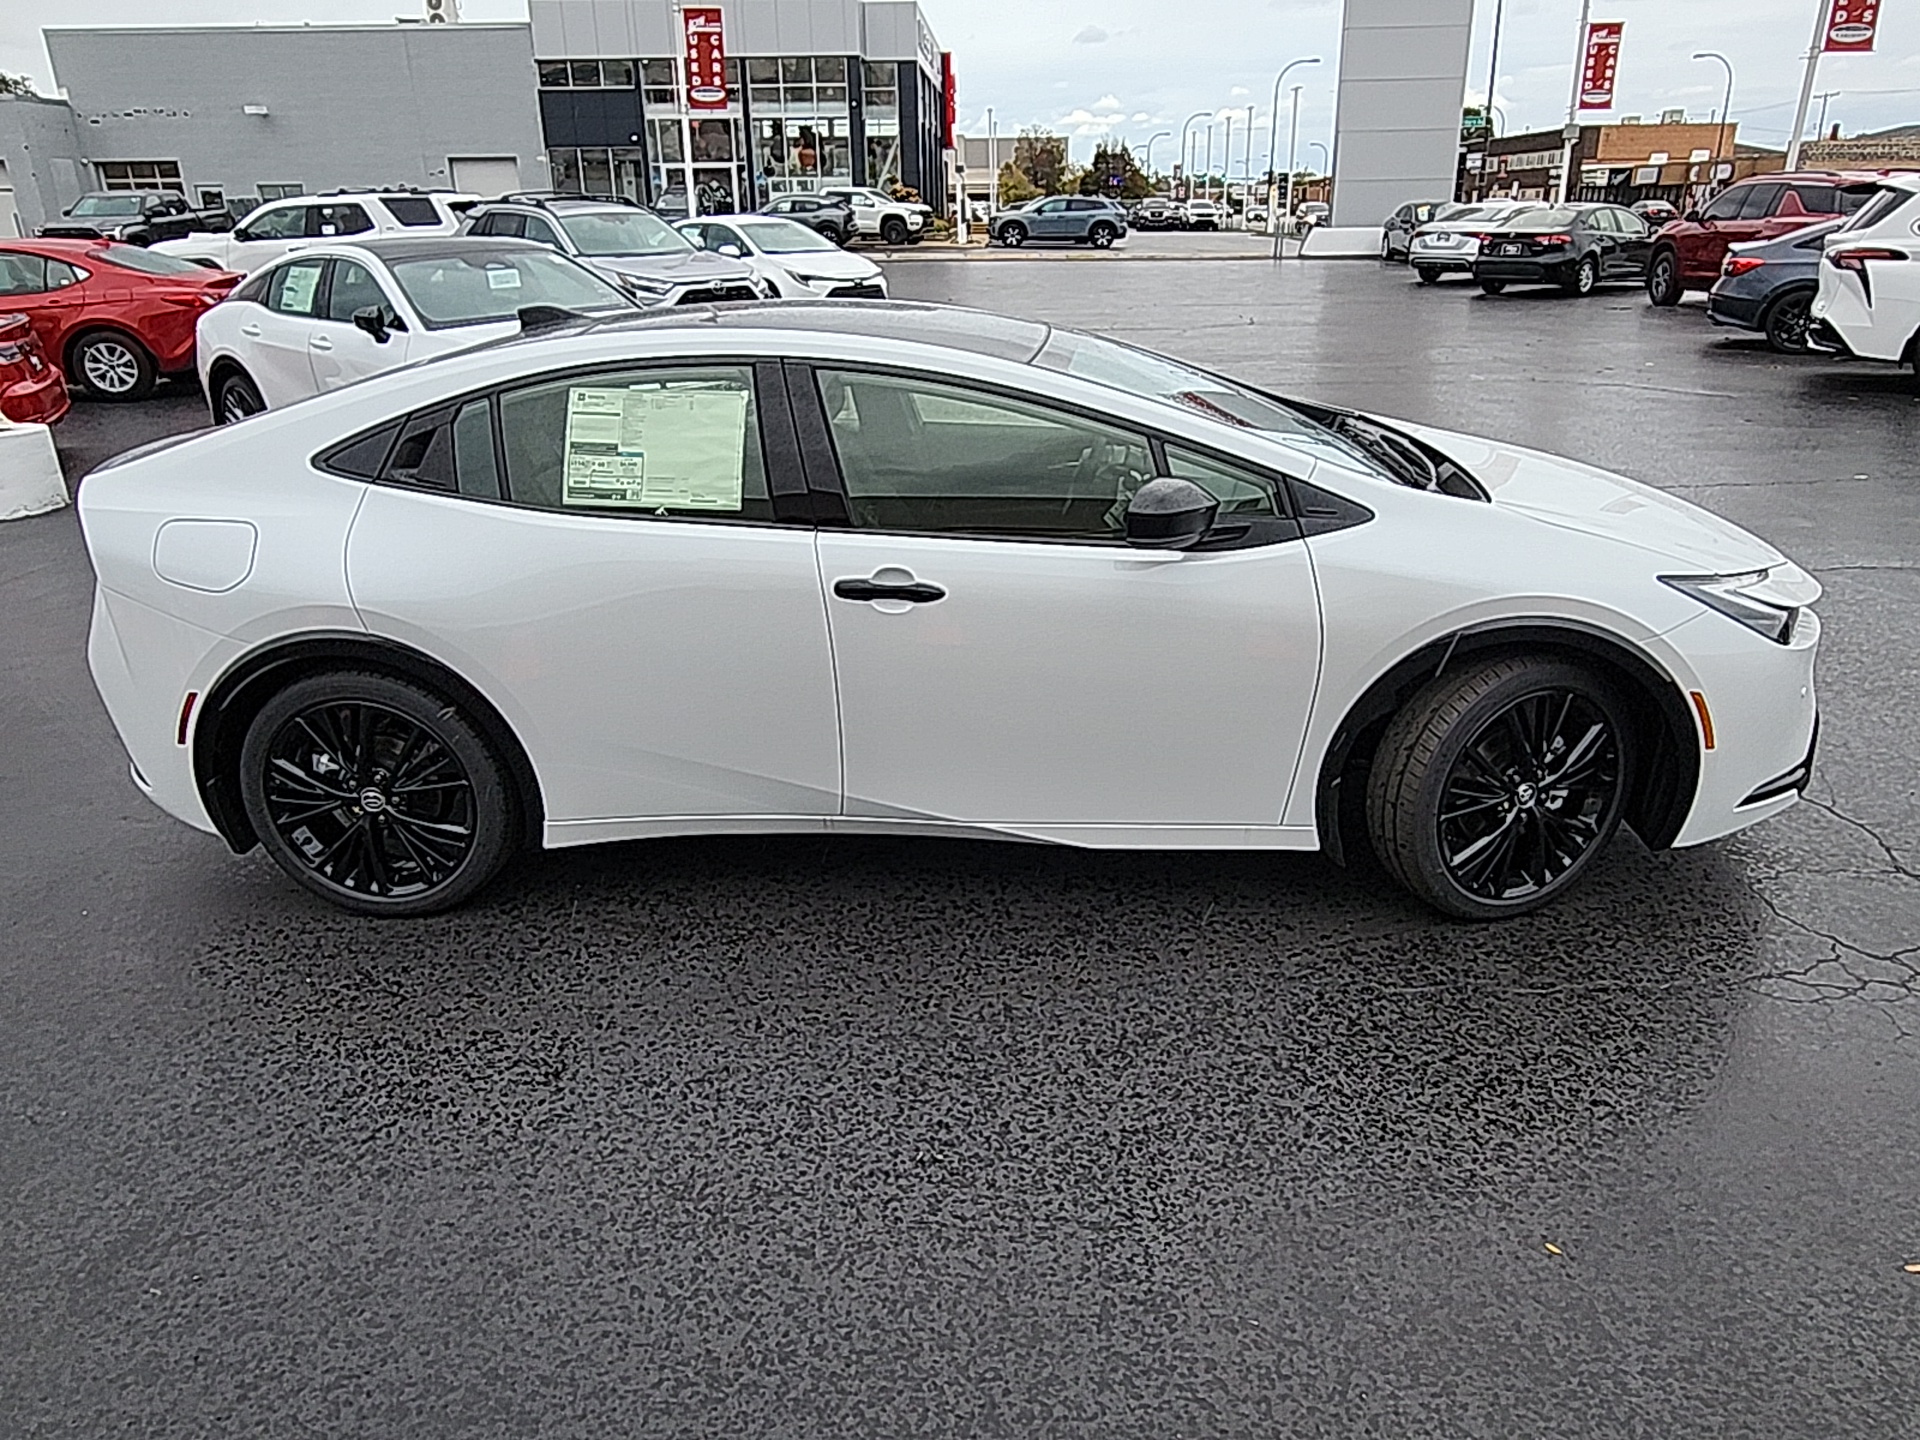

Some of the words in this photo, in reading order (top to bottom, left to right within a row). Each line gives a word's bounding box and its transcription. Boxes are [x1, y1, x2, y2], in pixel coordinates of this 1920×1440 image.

[689, 34, 701, 86] USED
[710, 34, 722, 86] CARS
[1583, 45, 1598, 90] USED
[1603, 45, 1617, 90] CARS
